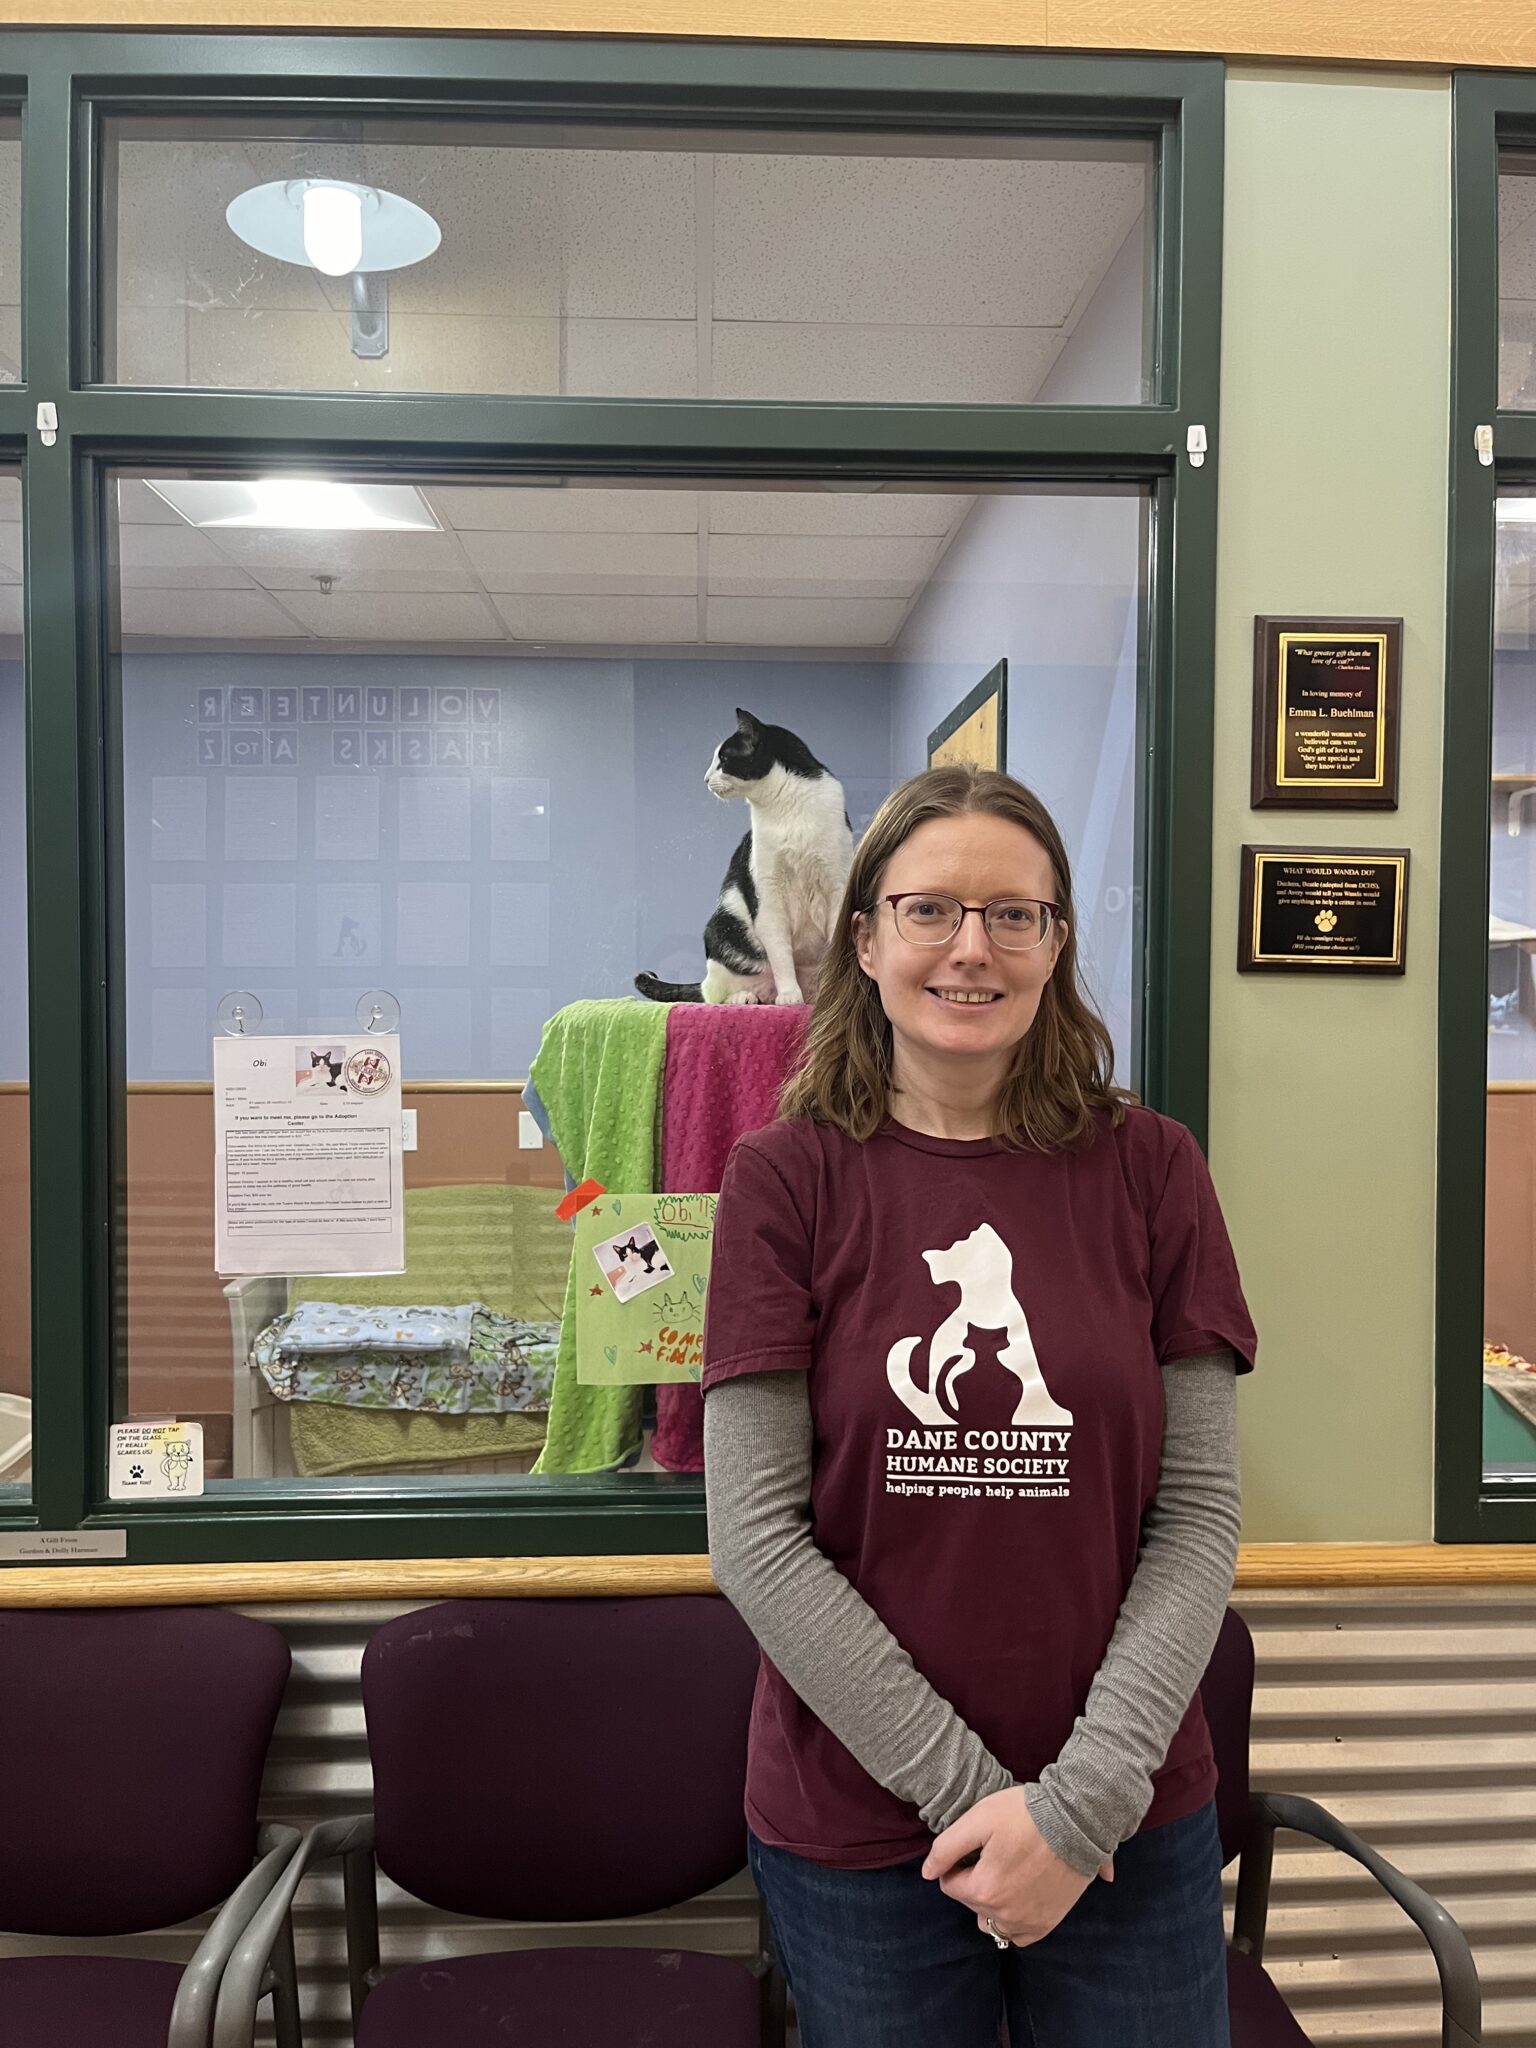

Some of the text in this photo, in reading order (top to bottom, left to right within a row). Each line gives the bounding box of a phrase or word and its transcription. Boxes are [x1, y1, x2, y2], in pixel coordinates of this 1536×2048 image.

[1289, 707, 1374, 718] Emma L. Buehlman
[253, 1059, 268, 1067] Obi
[689, 1352, 704, 1366] M
[886, 1428, 1072, 1451] DANE COUNTY
[886, 1455, 1069, 1474] HUMANE SOCIETY
[886, 1481, 1070, 1499] helping people help animals
